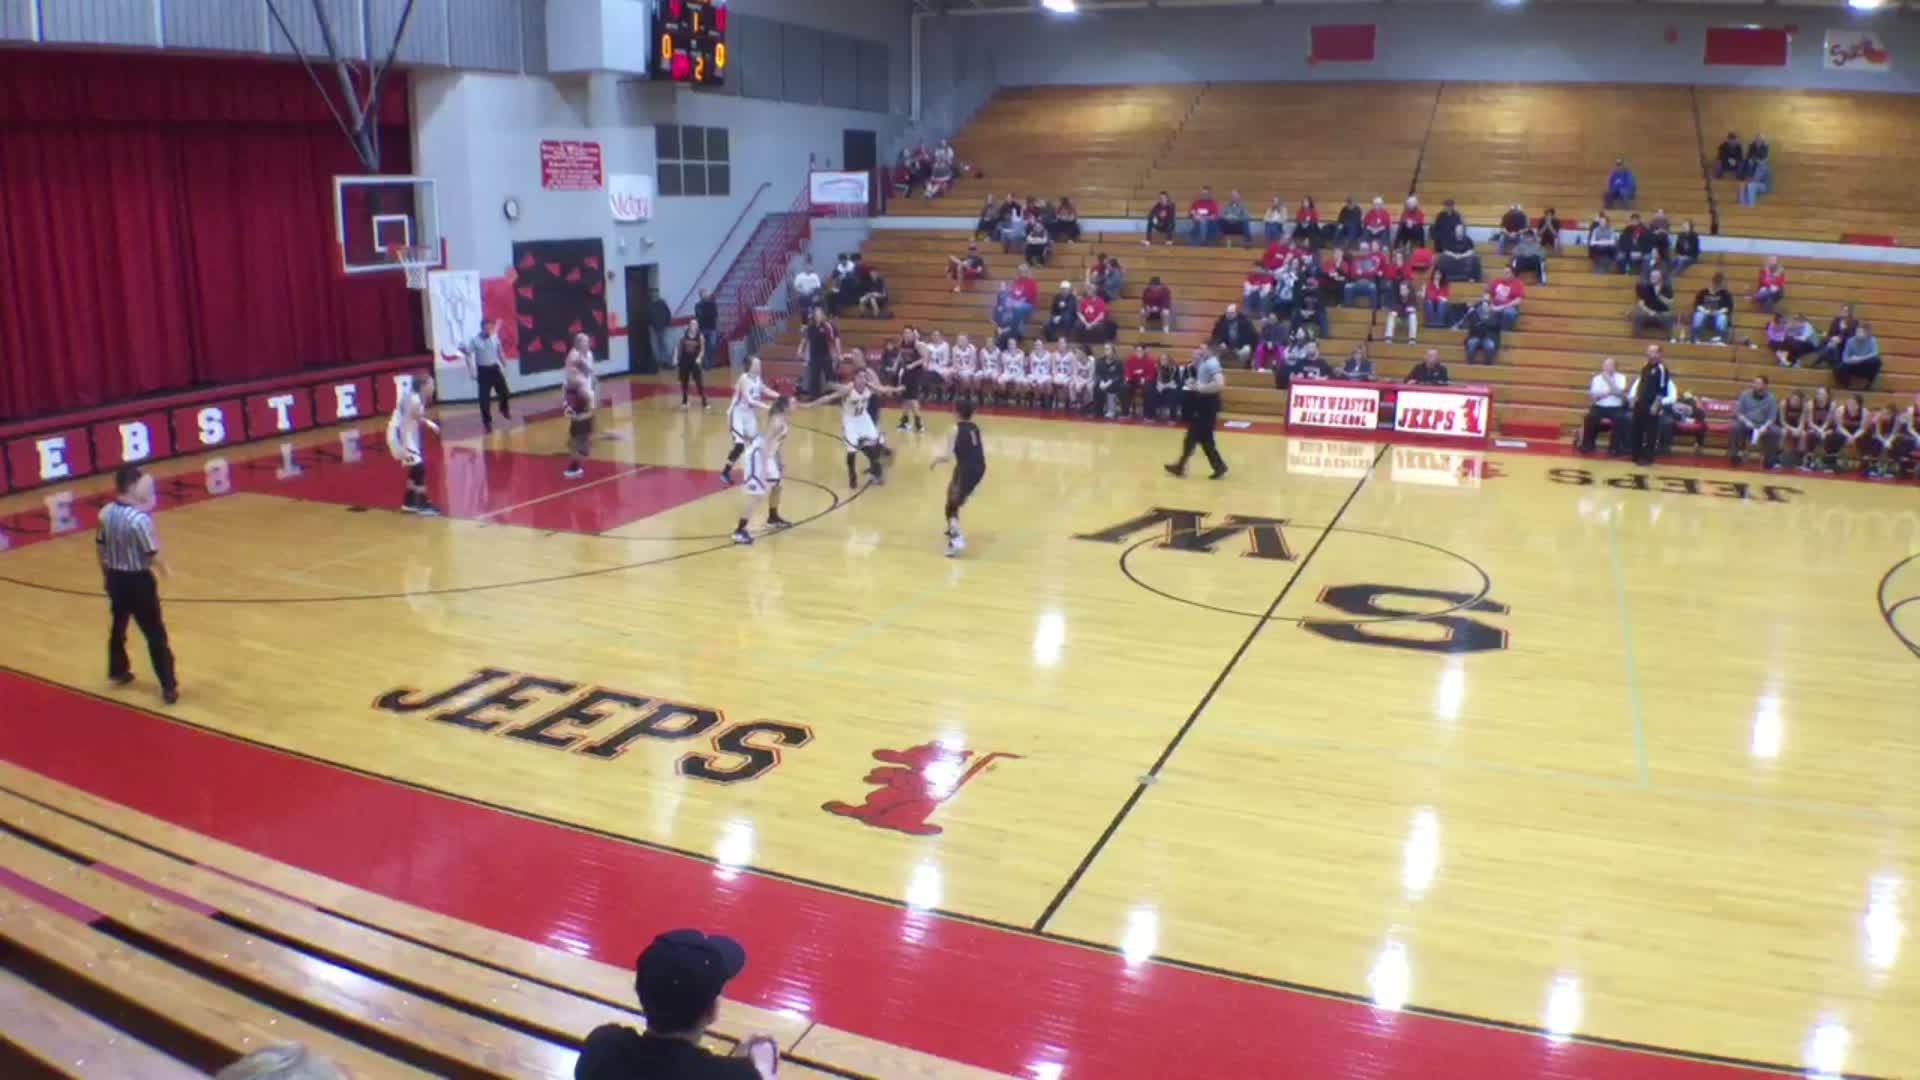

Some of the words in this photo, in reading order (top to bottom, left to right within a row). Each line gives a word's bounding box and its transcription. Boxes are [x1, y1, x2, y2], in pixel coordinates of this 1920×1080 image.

[661, 33, 672, 59] 0
[715, 43, 725, 68] 0
[695, 56, 704, 80] 2
[1398, 407, 1456, 430] JEEPS
[1548, 468, 1803, 503] JEEPS
[372, 666, 815, 787] JEEPS
